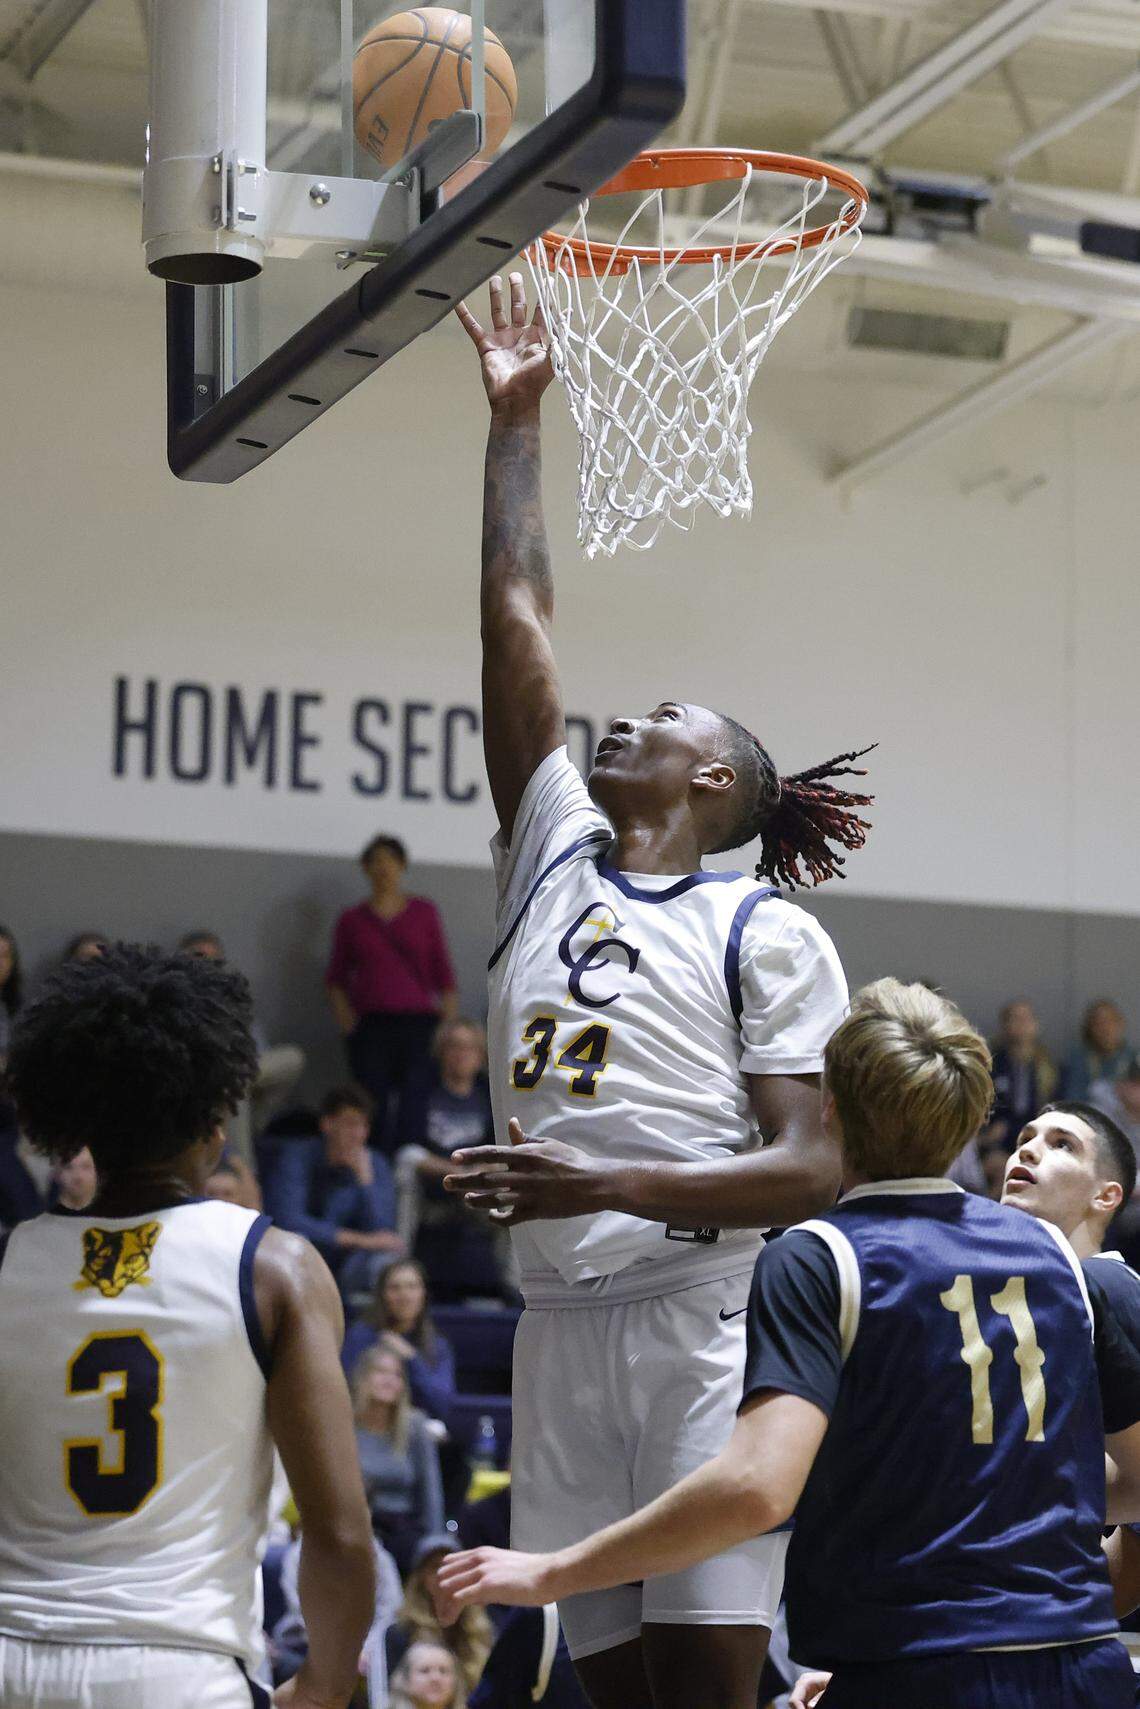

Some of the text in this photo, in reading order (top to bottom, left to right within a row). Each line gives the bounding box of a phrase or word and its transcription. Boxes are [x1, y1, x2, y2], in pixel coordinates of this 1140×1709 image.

[112, 674, 323, 791] HOME
[509, 1012, 613, 1099] 34
[63, 1328, 165, 1518] 3
[939, 1274, 1046, 1444] 11
